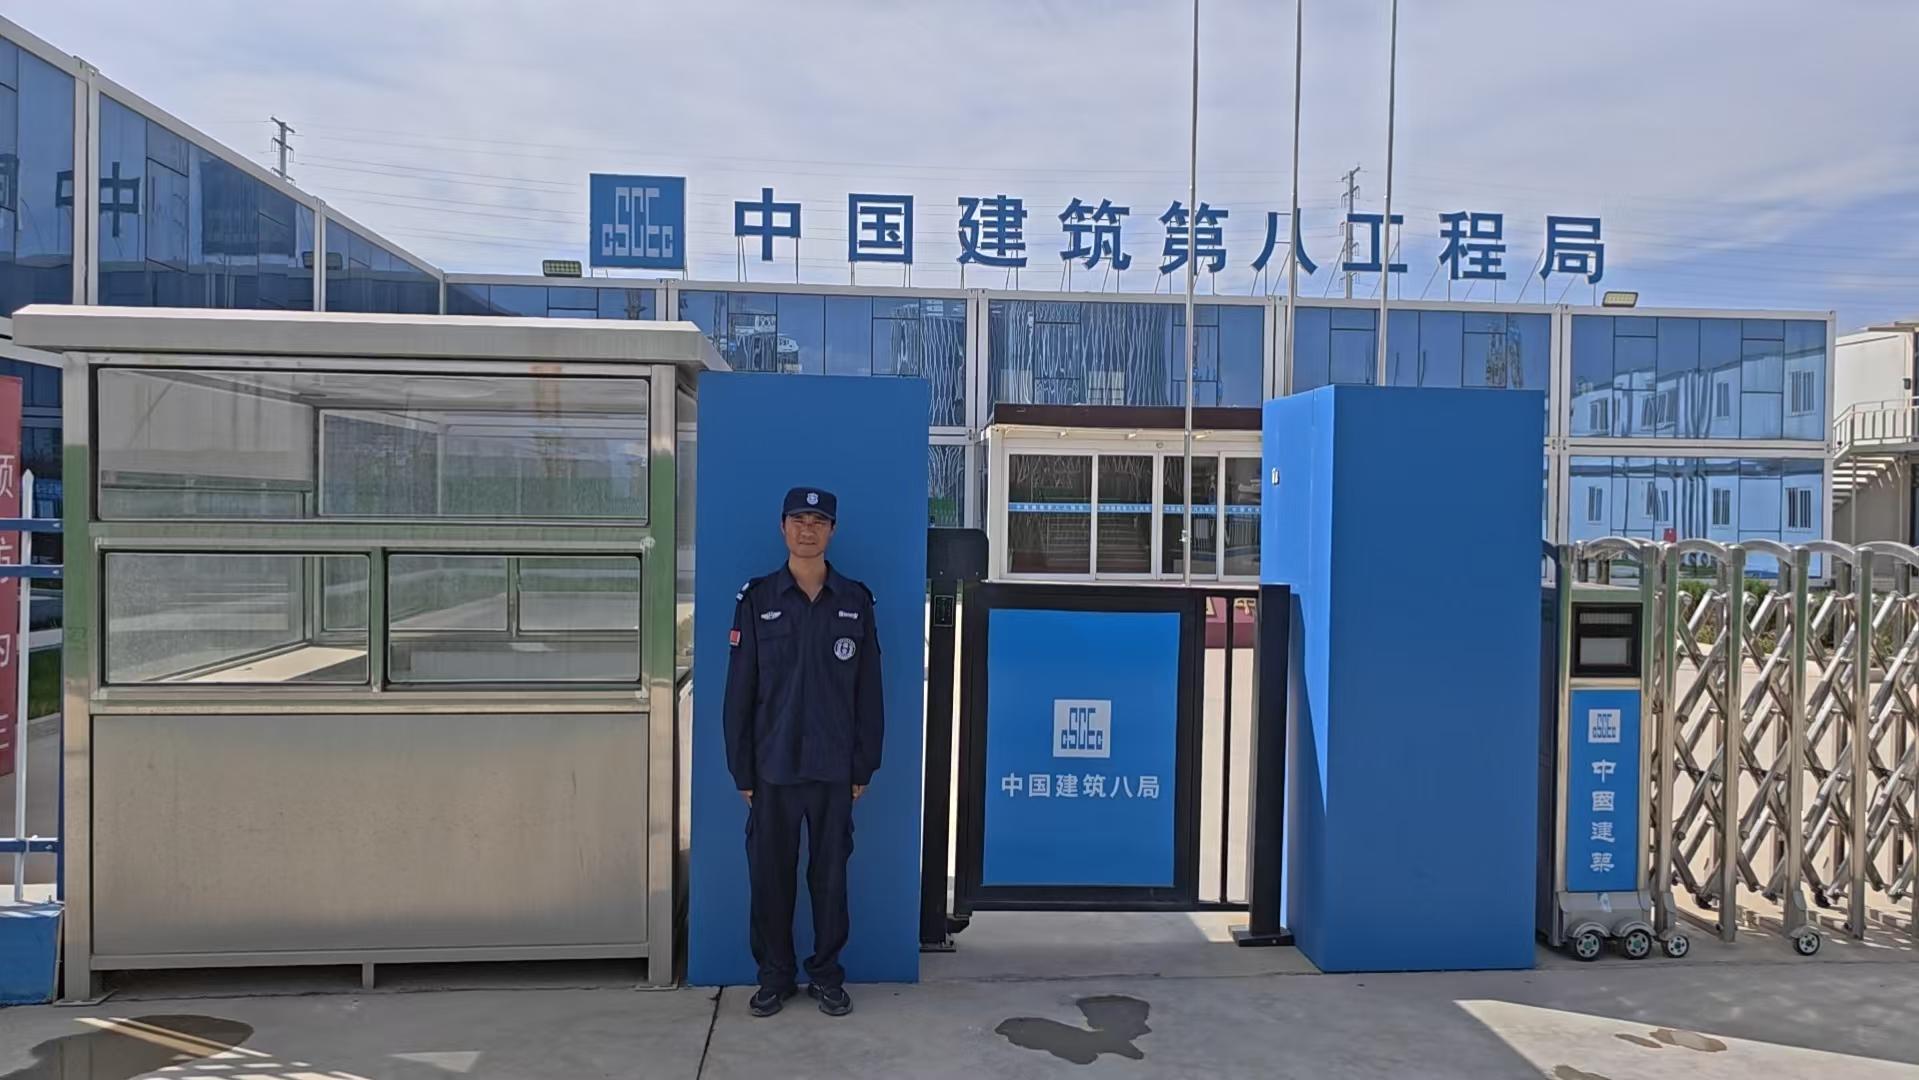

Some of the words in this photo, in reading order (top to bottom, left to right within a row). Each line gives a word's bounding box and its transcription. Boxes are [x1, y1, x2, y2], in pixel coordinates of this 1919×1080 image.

[734, 187, 1605, 284] 中国建筑第八工程局
[1001, 773, 1160, 799] 中国建筑八局
